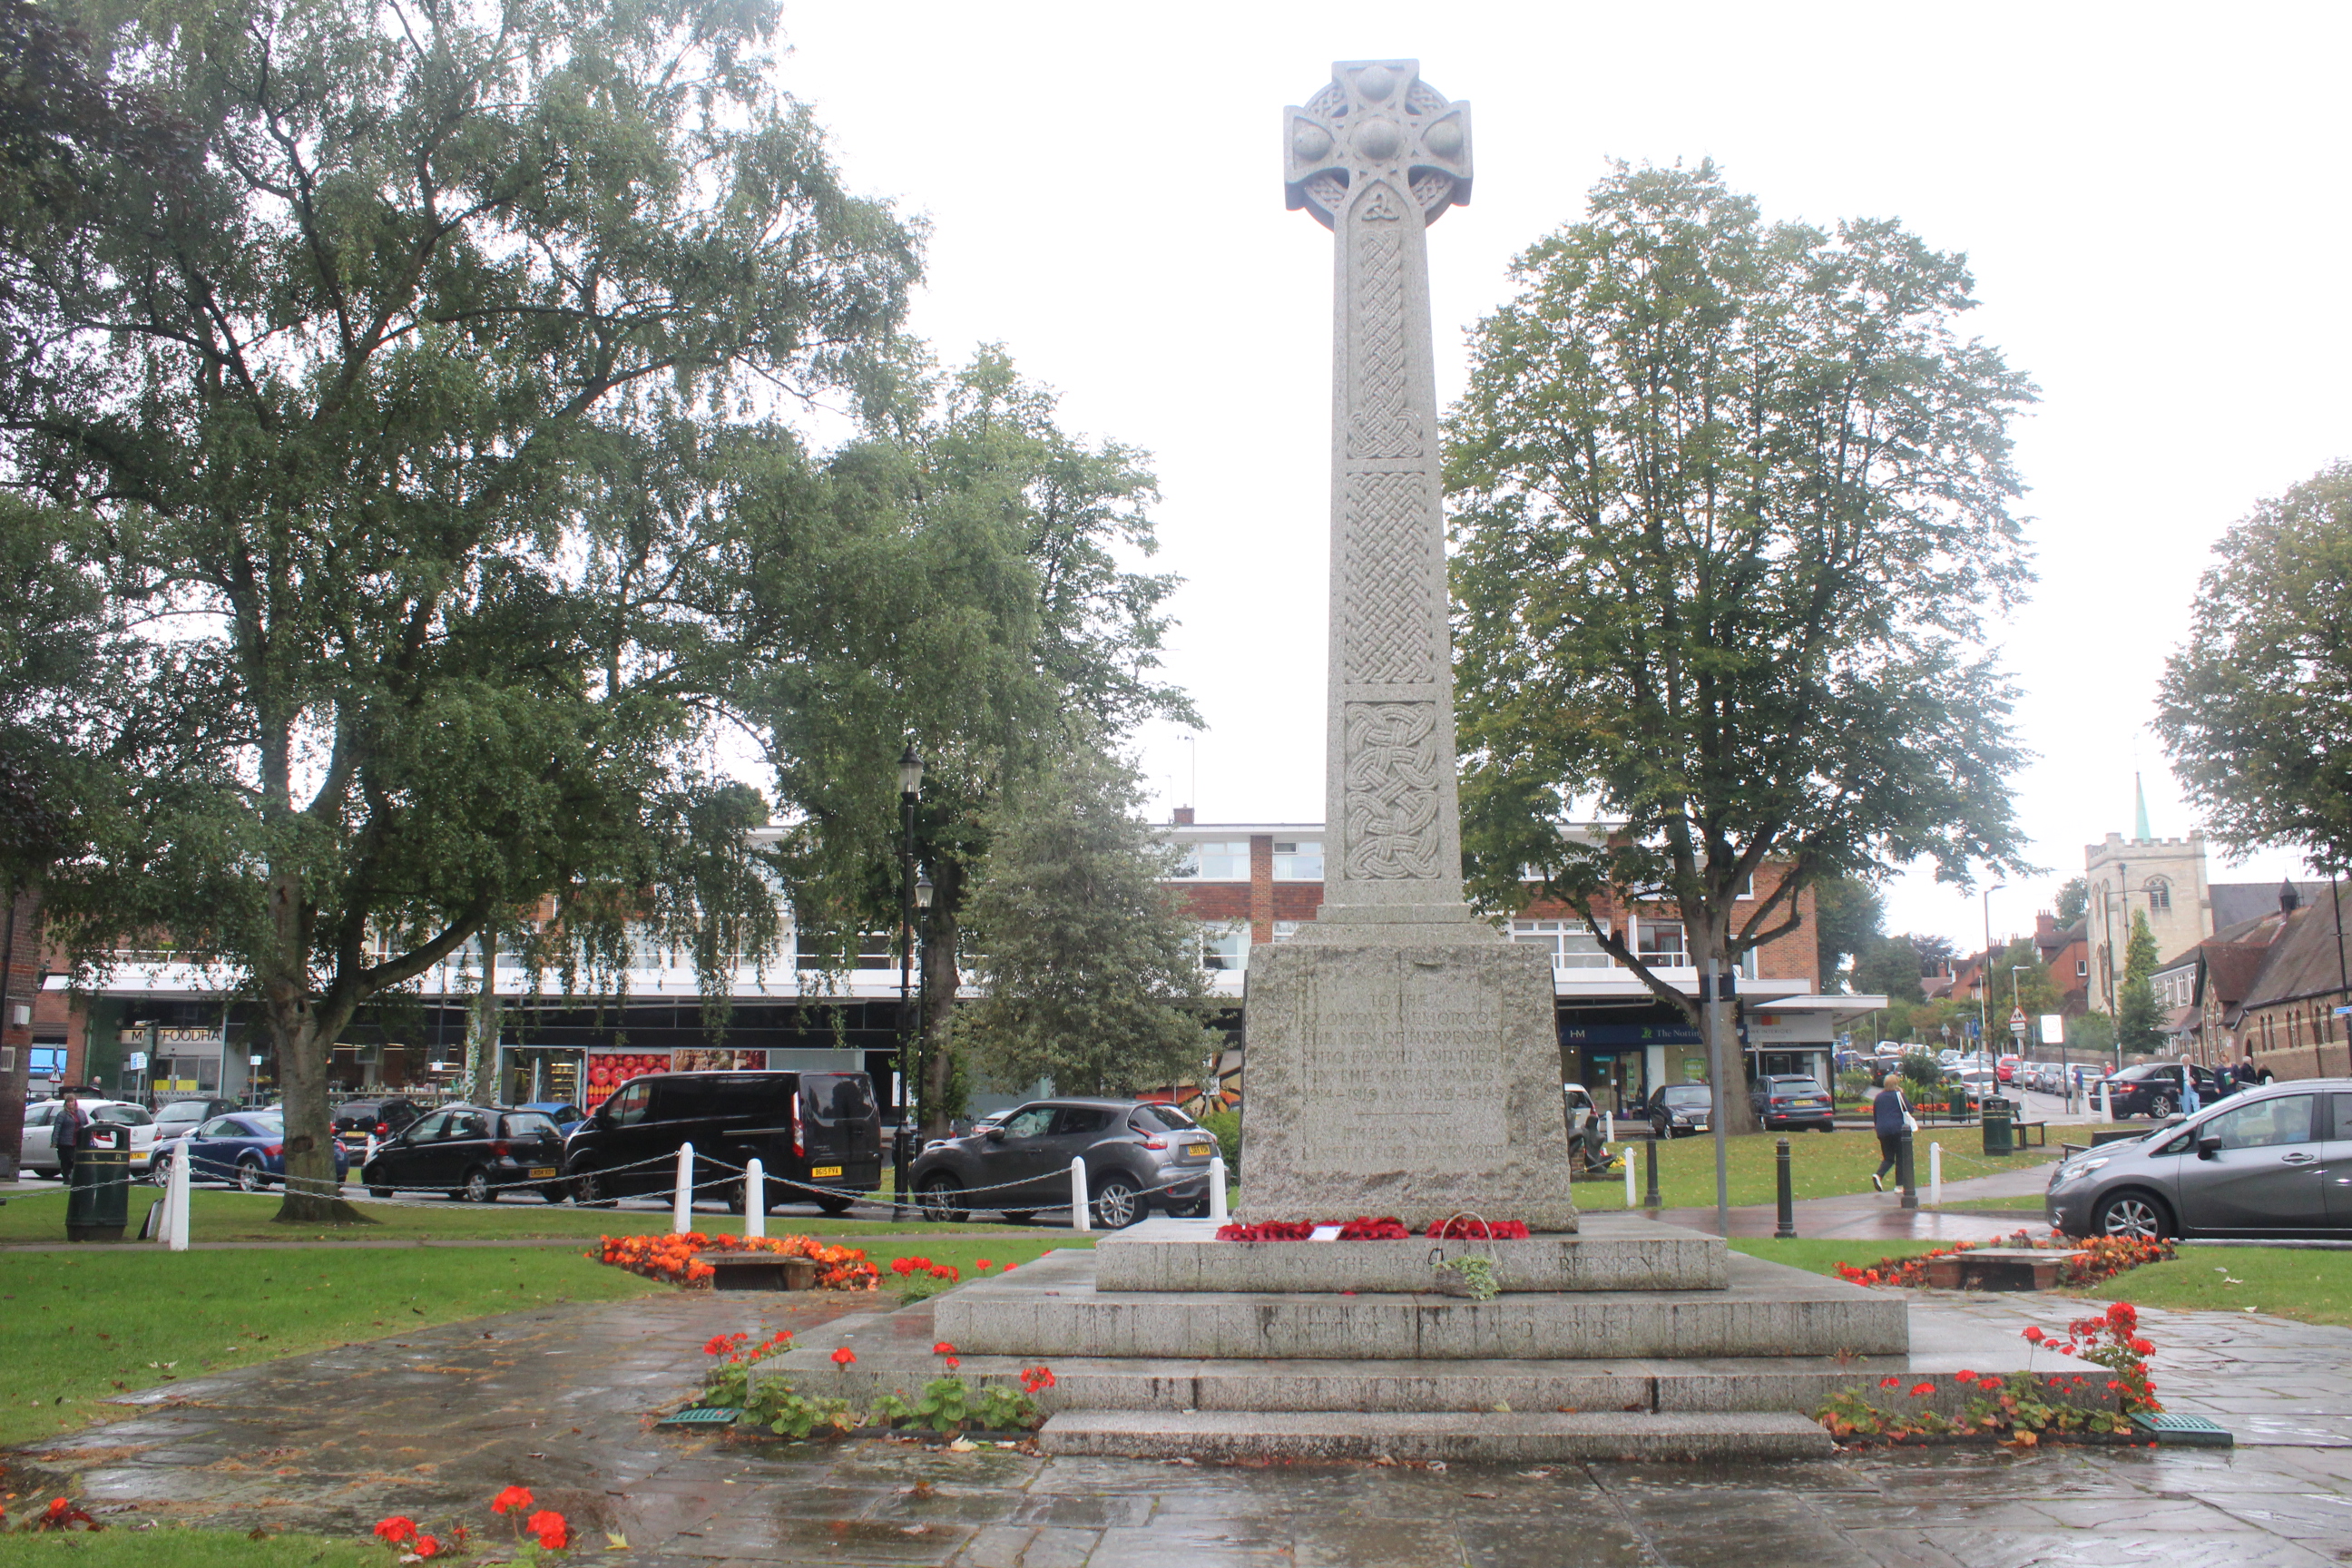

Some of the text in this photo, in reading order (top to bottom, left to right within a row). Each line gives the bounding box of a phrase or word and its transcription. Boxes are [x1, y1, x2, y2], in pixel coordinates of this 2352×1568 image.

[1658, 1029, 1671, 1037] The
[1340, 1069, 1373, 1083] THE
[1332, 1256, 1372, 1272] THE
